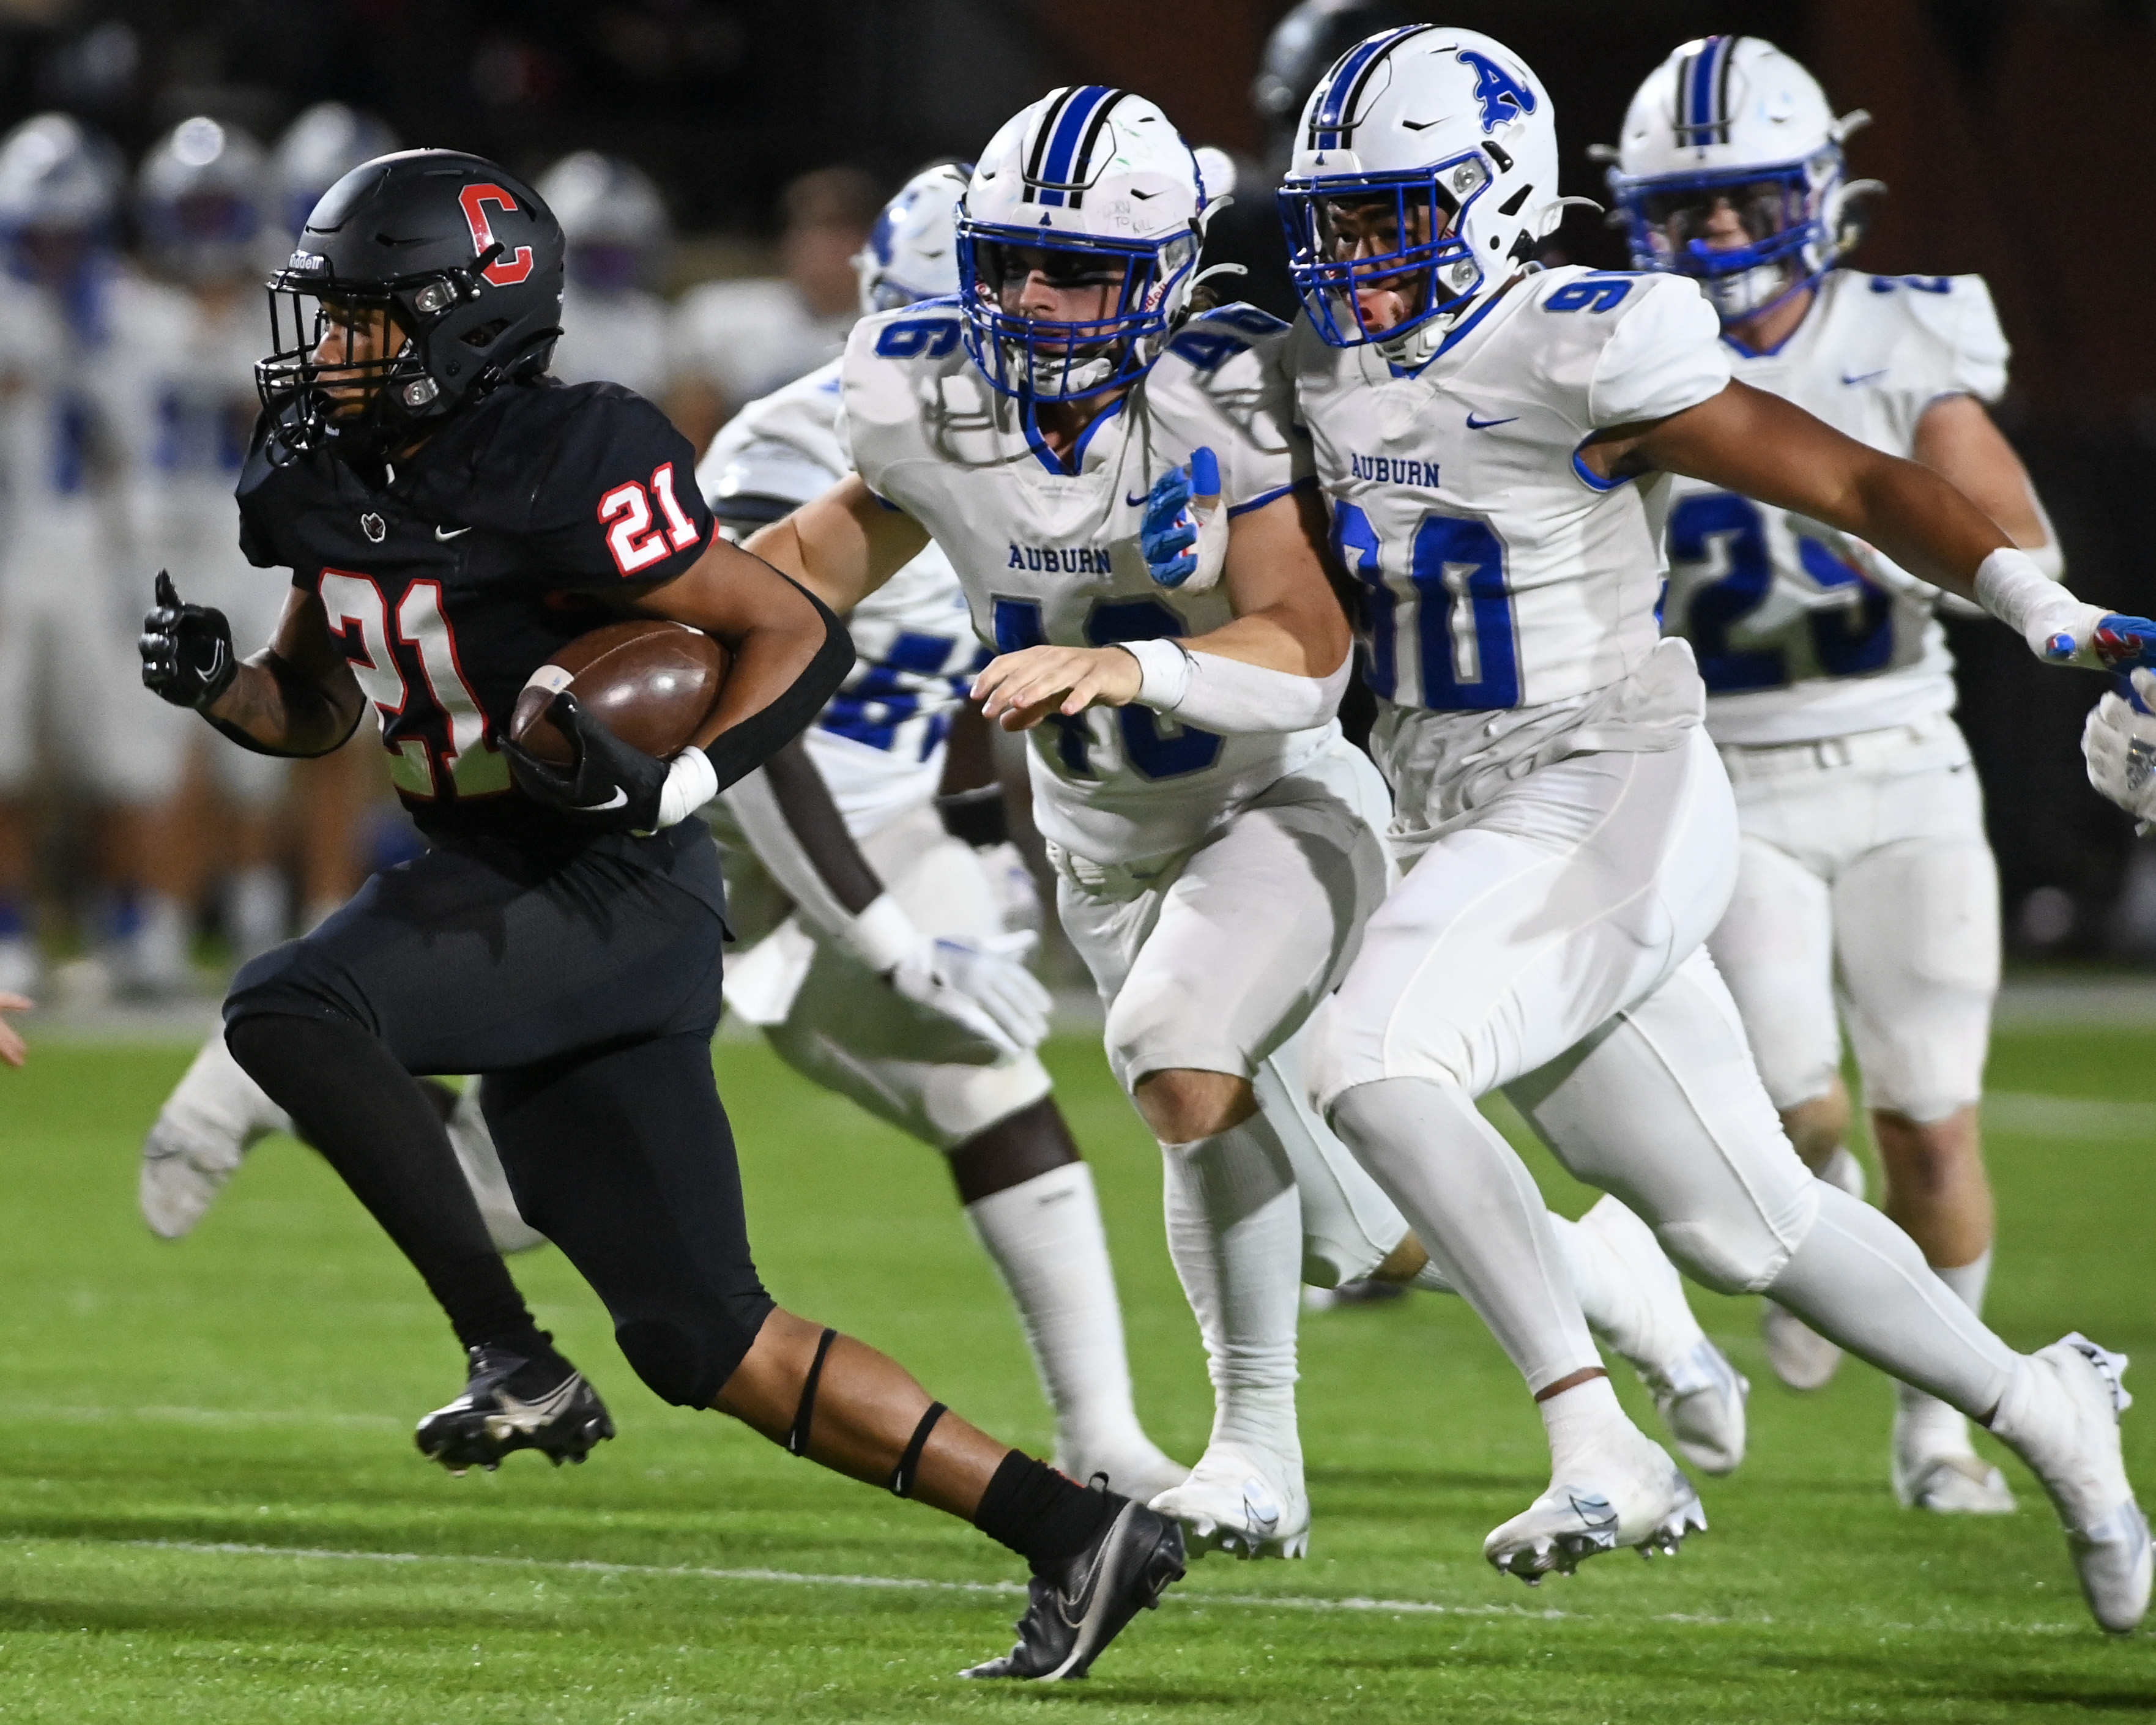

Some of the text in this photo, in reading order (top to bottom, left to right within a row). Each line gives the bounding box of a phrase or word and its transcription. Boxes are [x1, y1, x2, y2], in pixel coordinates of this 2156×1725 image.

[1455, 49, 1537, 134] A
[289, 251, 320, 270] Riddell
[458, 183, 533, 288] C
[1542, 270, 1646, 314] 9
[1351, 452, 1440, 489] AUBURN
[597, 461, 701, 577] 21
[1008, 543, 1112, 574] AUBURN
[318, 566, 514, 801] 21
